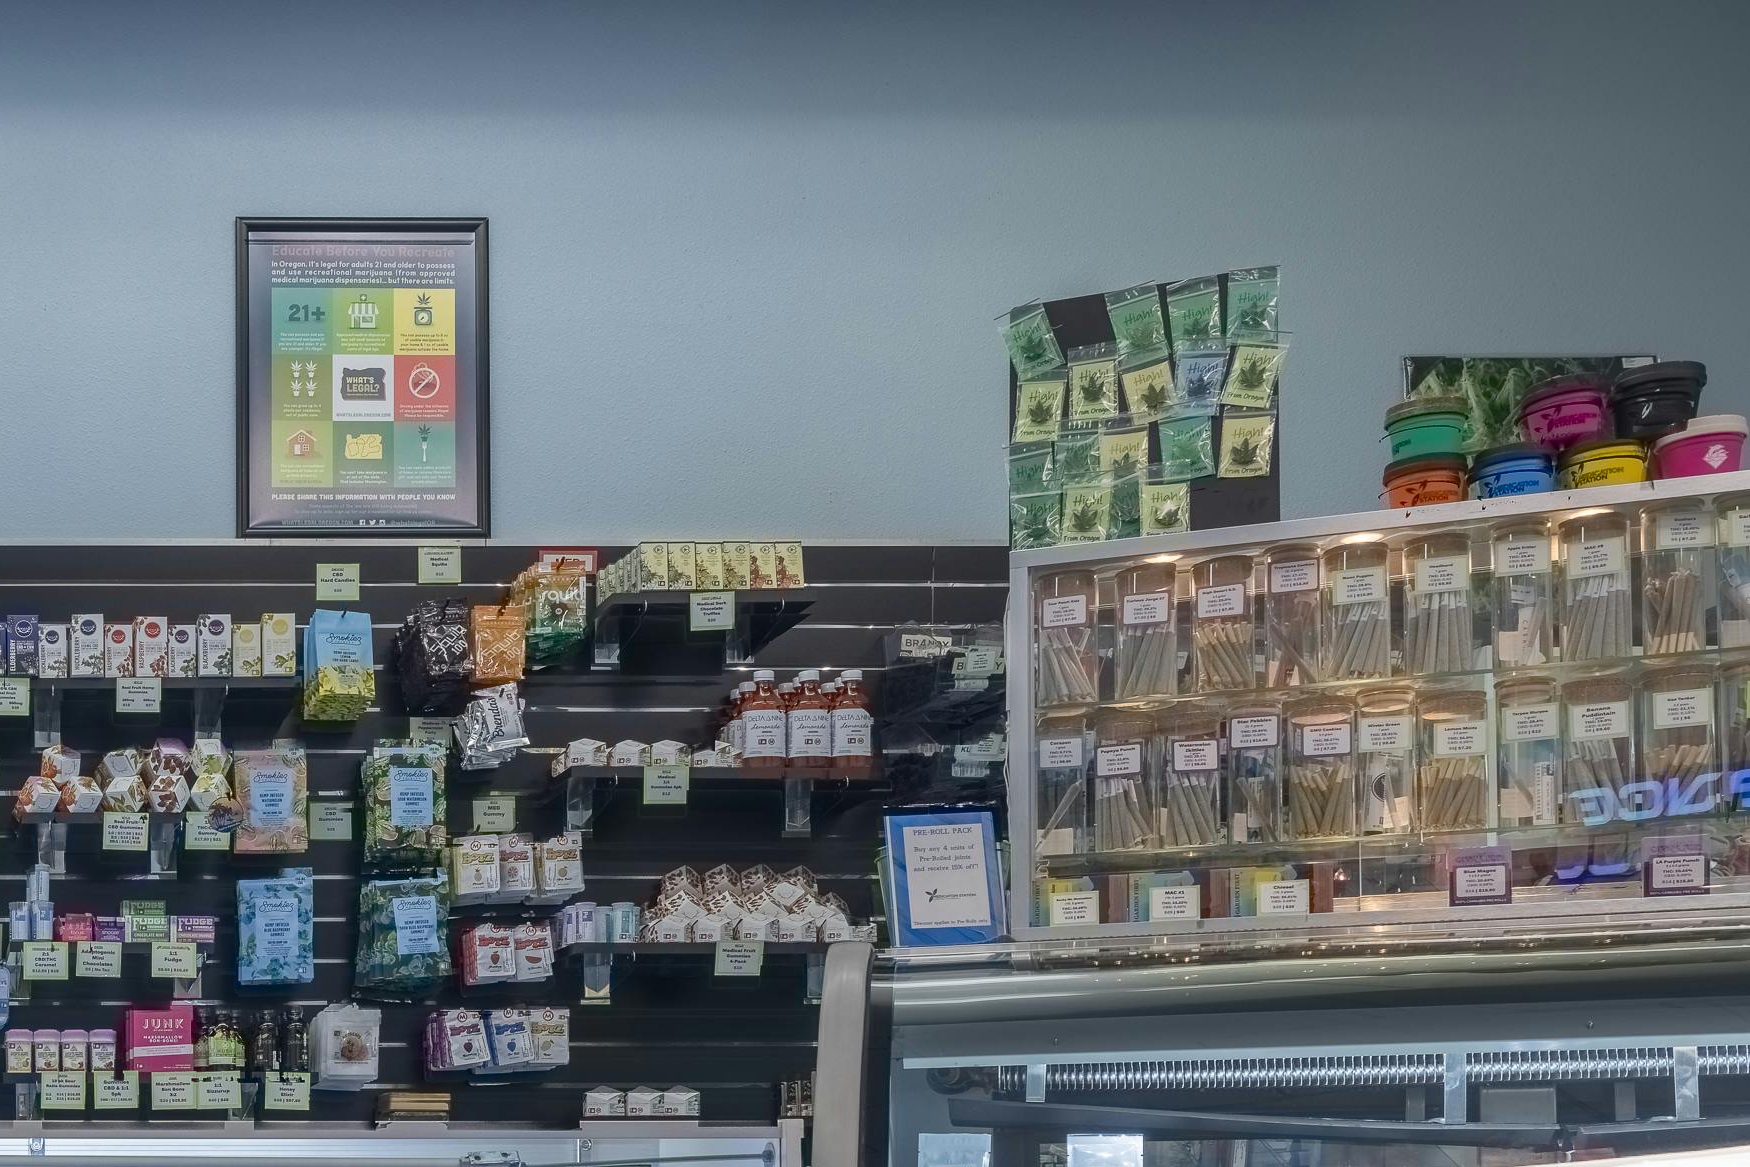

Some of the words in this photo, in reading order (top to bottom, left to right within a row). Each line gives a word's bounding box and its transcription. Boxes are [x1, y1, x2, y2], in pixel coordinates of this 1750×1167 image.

[289, 304, 325, 322] 21+
[347, 383, 379, 393] LEGAL?
[1234, 428, 1264, 439] High!
[913, 828, 949, 836] PRE-ROLL
[133, 918, 168, 931] FUDGE
[142, 1019, 184, 1029] JUNK
